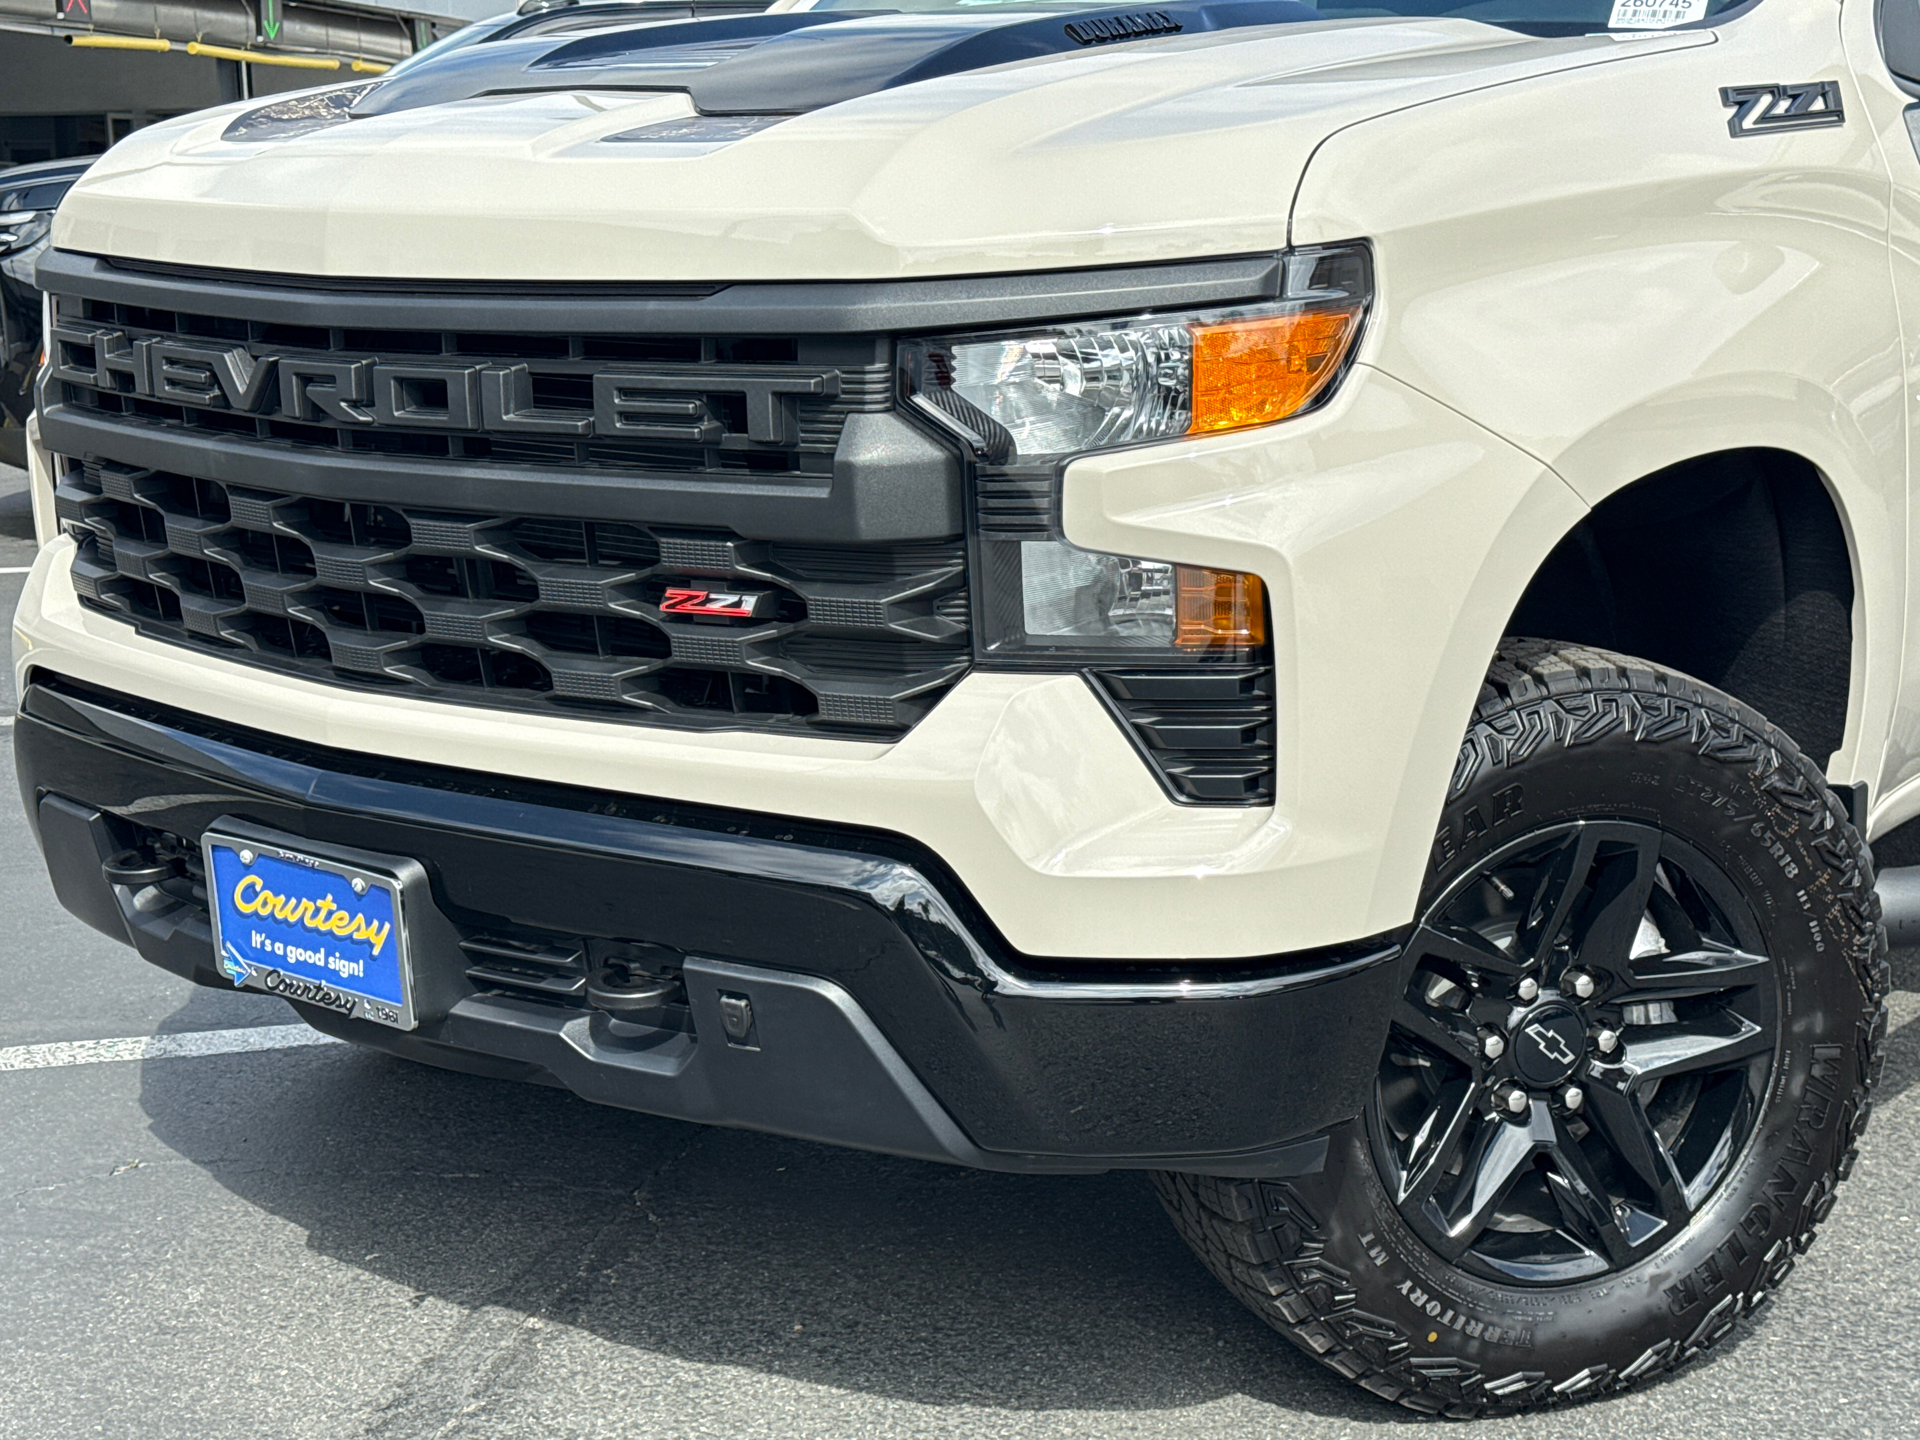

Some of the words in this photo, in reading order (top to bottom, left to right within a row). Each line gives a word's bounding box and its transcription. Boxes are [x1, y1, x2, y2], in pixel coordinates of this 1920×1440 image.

[1066, 10, 1183, 44] DURAMAX
[1719, 80, 1846, 138] Z71
[50, 325, 841, 445] CHEVROLET
[660, 588, 759, 617] Z71
[233, 874, 391, 956] Courtesy
[251, 930, 272, 952] It's
[274, 941, 284, 955] a
[286, 945, 325, 967] good
[328, 952, 364, 977] sign!
[264, 968, 359, 1020] Courtesy
[1664, 1044, 1844, 1316] WRANGLER
[1358, 1231, 1390, 1267] MT
[1395, 1279, 1532, 1347] TERRITORY
